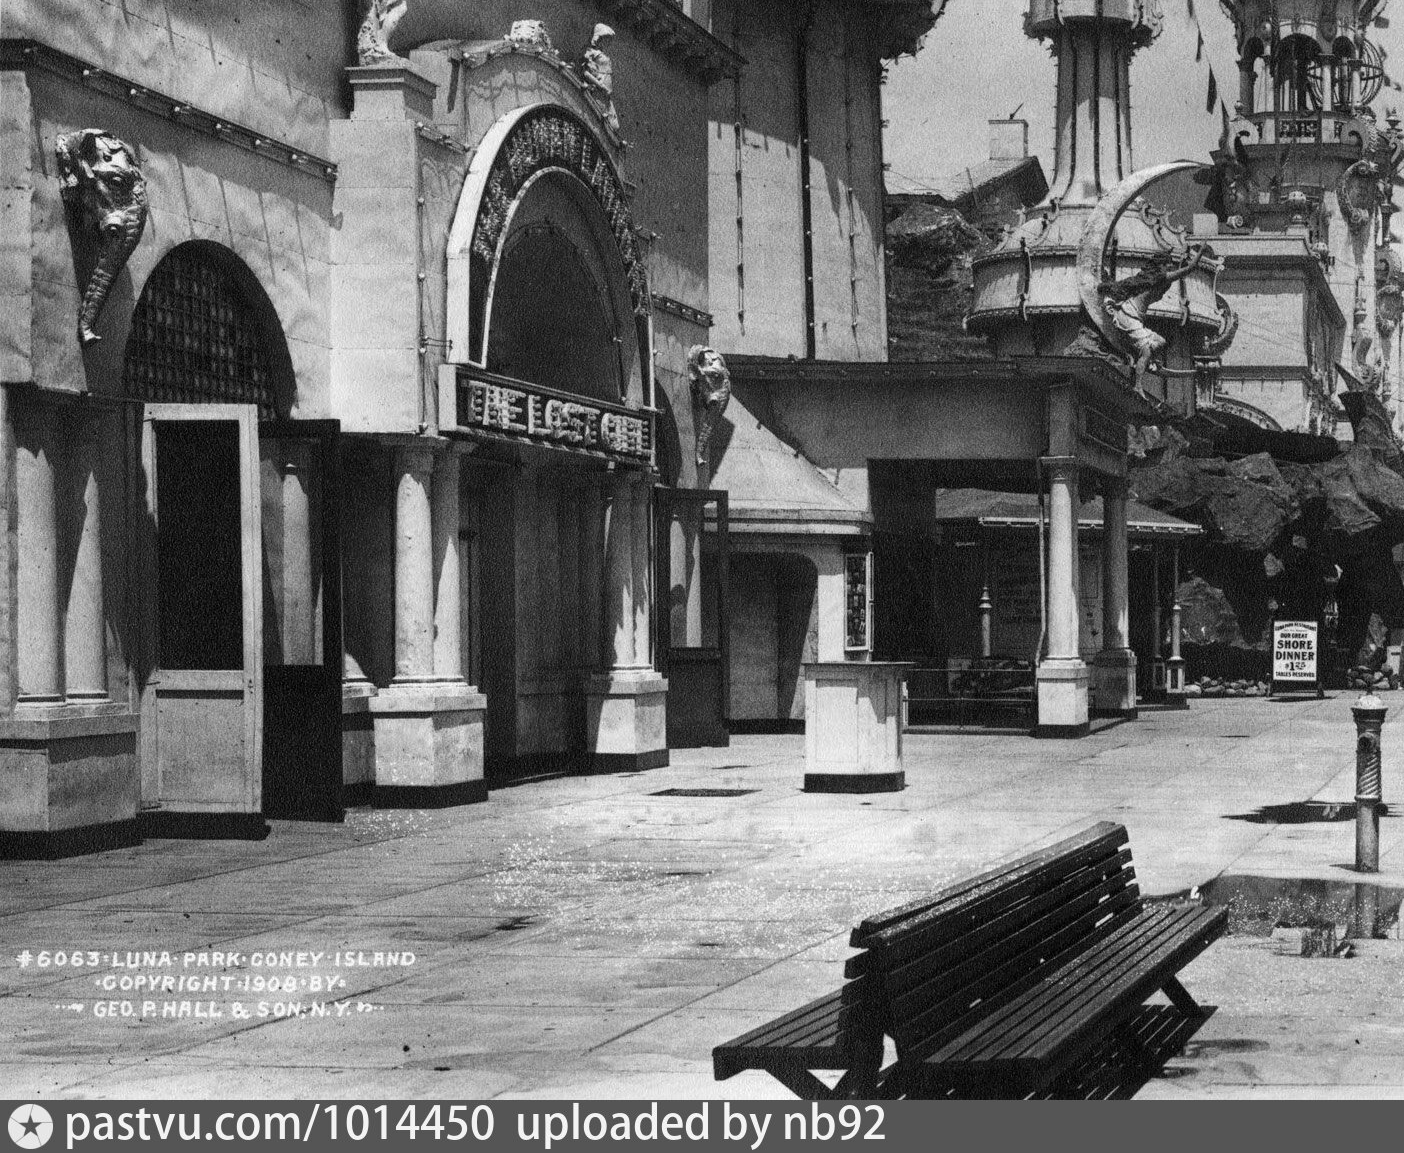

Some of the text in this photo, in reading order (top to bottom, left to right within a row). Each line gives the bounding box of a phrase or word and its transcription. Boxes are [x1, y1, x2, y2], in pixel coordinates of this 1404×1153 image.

[462, 380, 527, 430] THE
[528, 395, 601, 445] LOST
[1277, 640, 1313, 650] SHORE
[1276, 651, 1315, 660] DINNER
